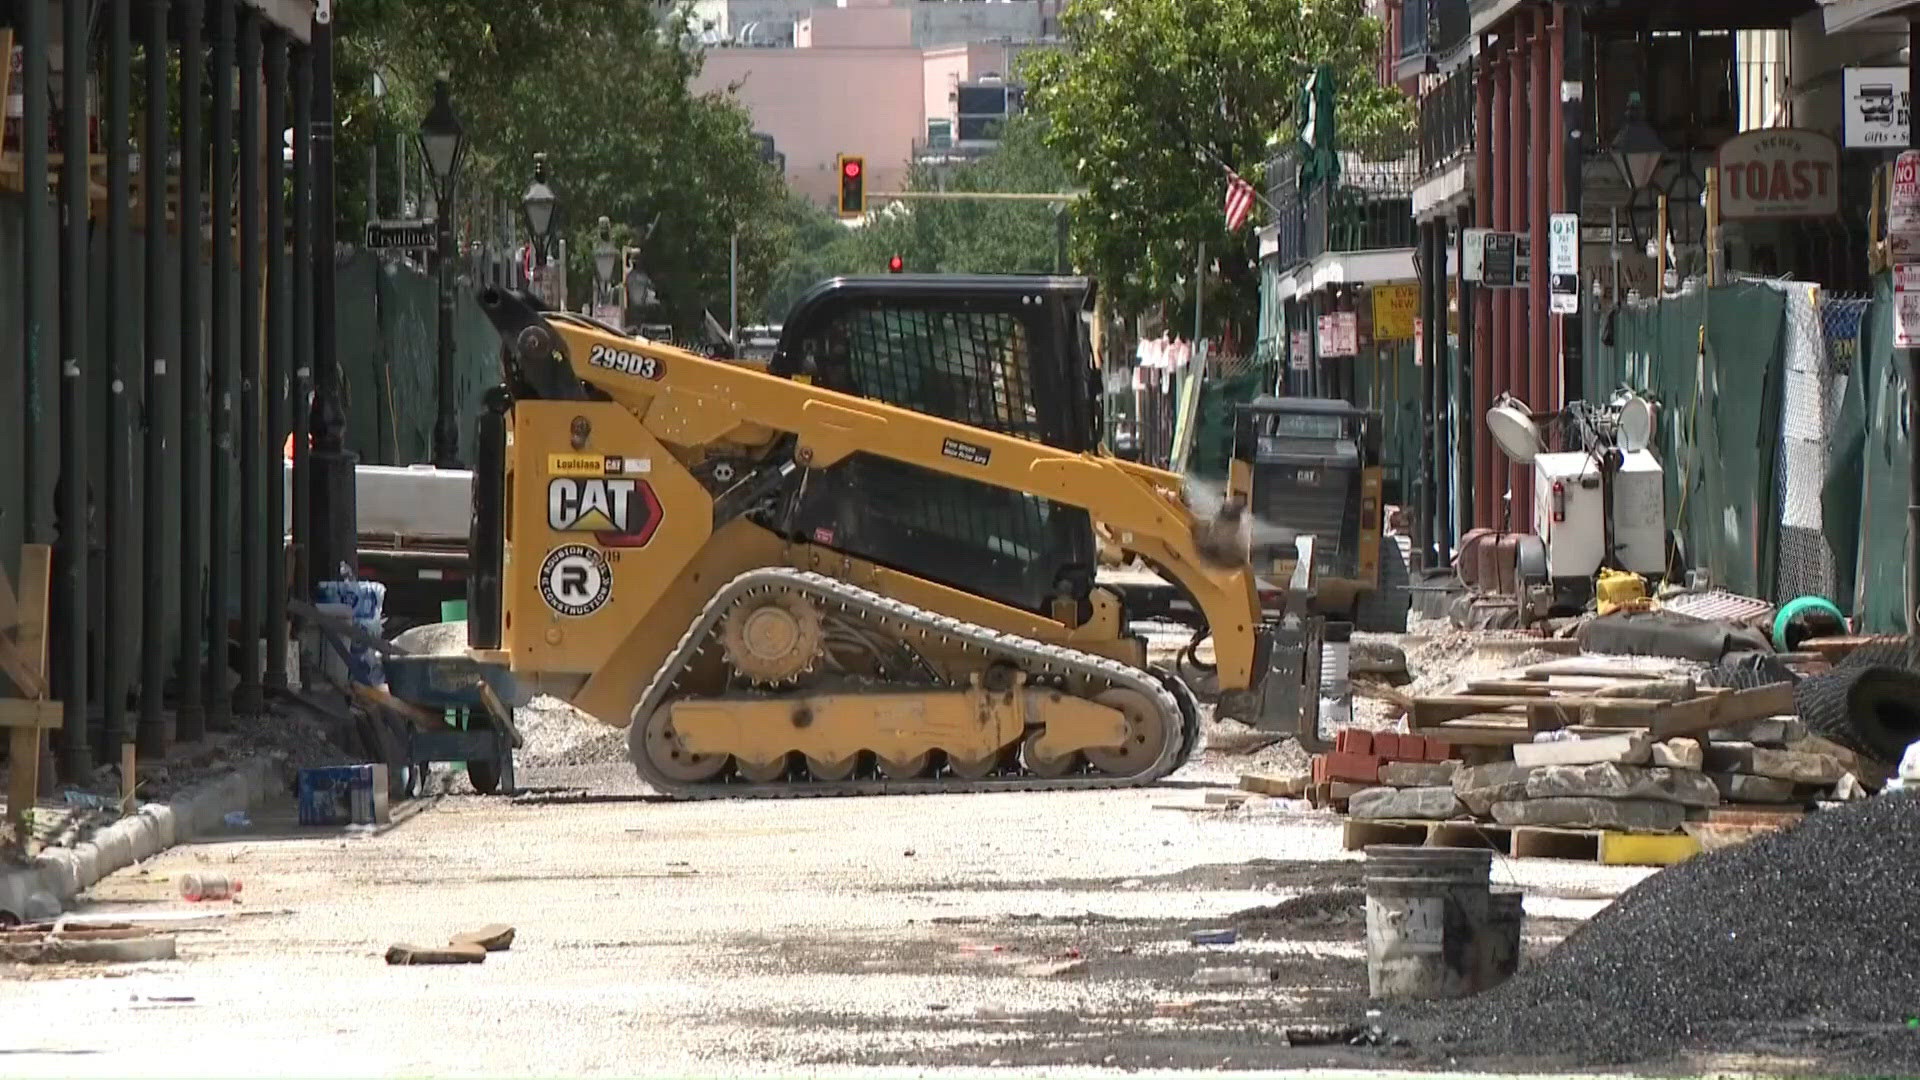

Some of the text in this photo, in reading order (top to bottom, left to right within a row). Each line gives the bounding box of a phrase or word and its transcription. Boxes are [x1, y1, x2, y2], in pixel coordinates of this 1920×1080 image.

[1725, 159, 1833, 201] TOAST
[1896, 165, 1914, 183] NO
[370, 230, 435, 246] Ursulines
[590, 344, 657, 379] 299D3
[557, 460, 600, 470] Louisiana
[605, 460, 621, 471] CAT
[1297, 470, 1315, 481] CAT
[549, 479, 635, 531] CAT
[562, 566, 590, 596] R
[543, 586, 609, 615] CONSTRUCTION
